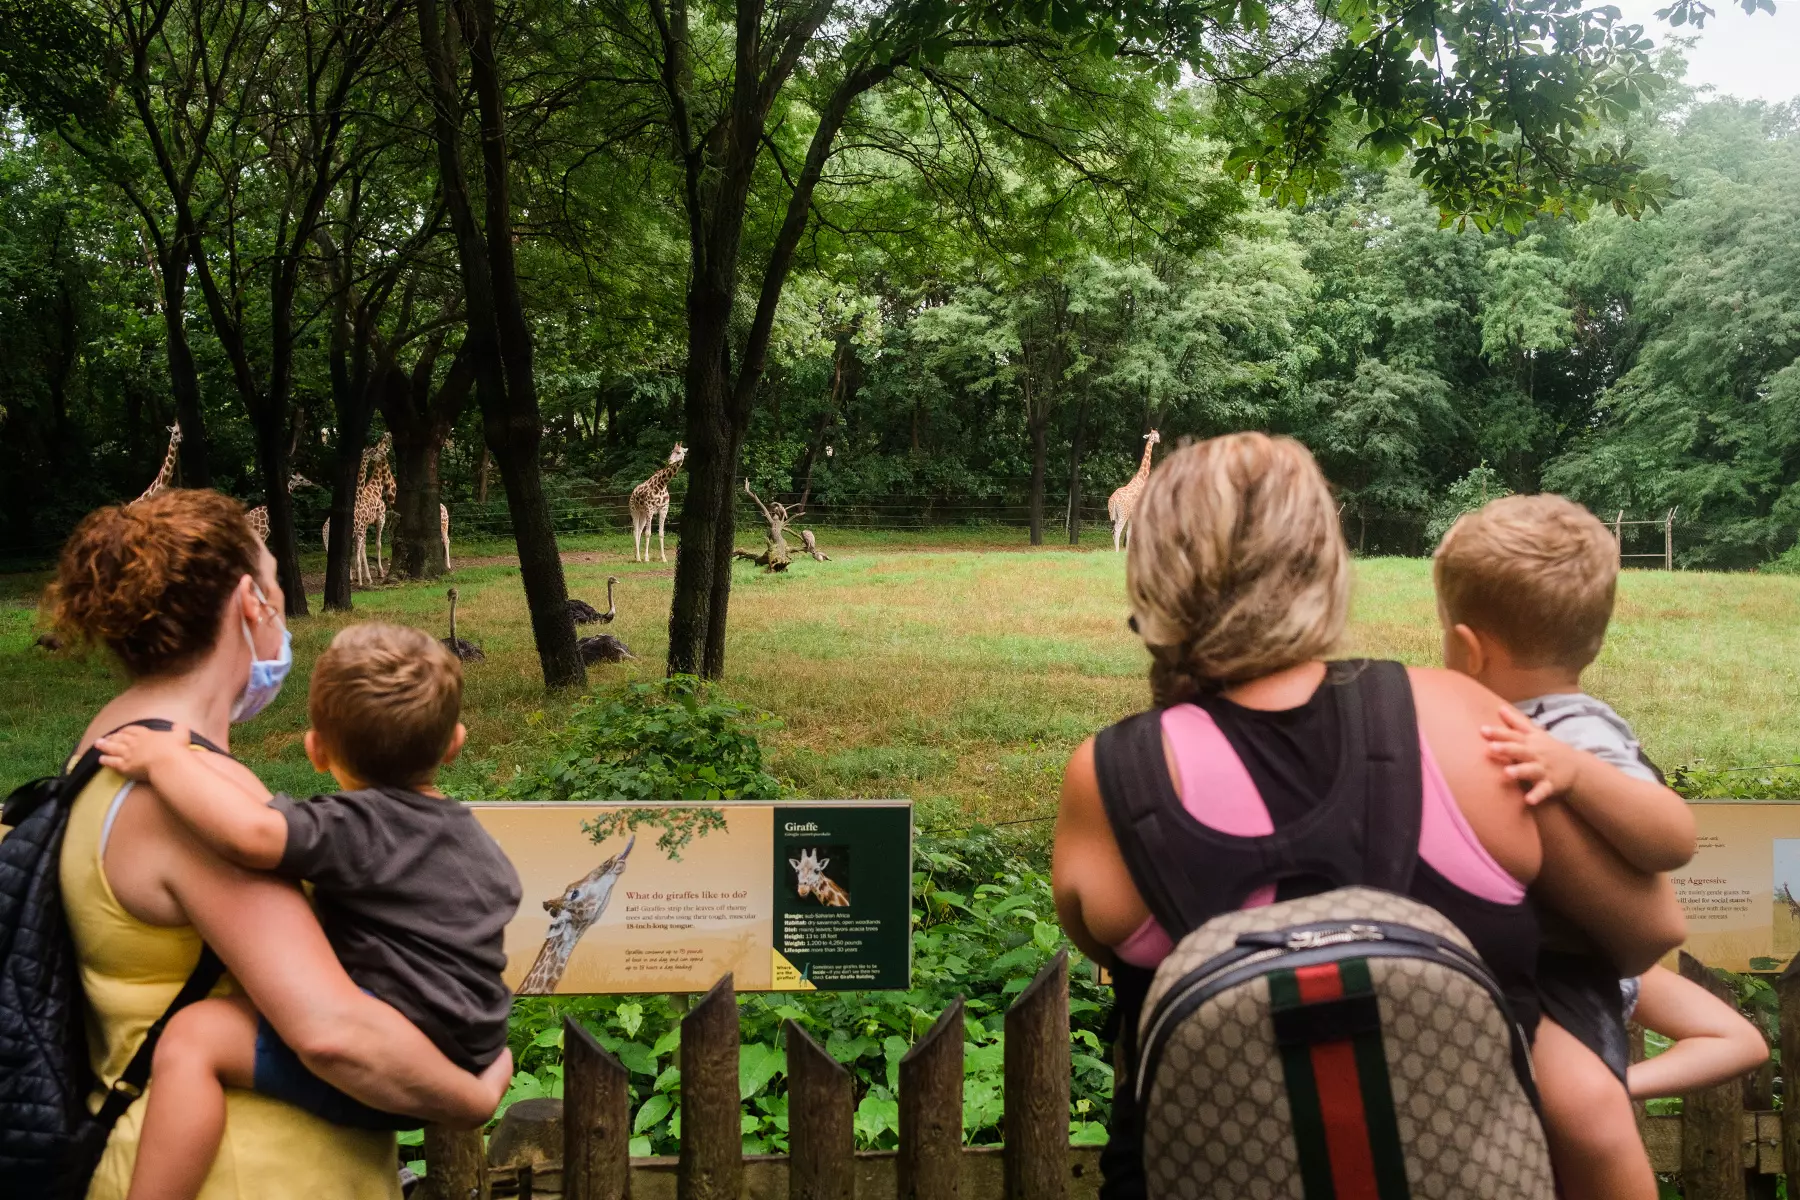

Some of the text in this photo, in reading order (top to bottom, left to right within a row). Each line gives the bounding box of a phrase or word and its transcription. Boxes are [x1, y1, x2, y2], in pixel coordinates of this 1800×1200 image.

[785, 822, 818, 832] Giraffe
[1688, 877, 1727, 886] Aggressive
[626, 891, 650, 899] What
[652, 891, 663, 899] do
[666, 891, 699, 901] giraffes
[702, 891, 718, 899] like
[732, 890, 747, 899] do?
